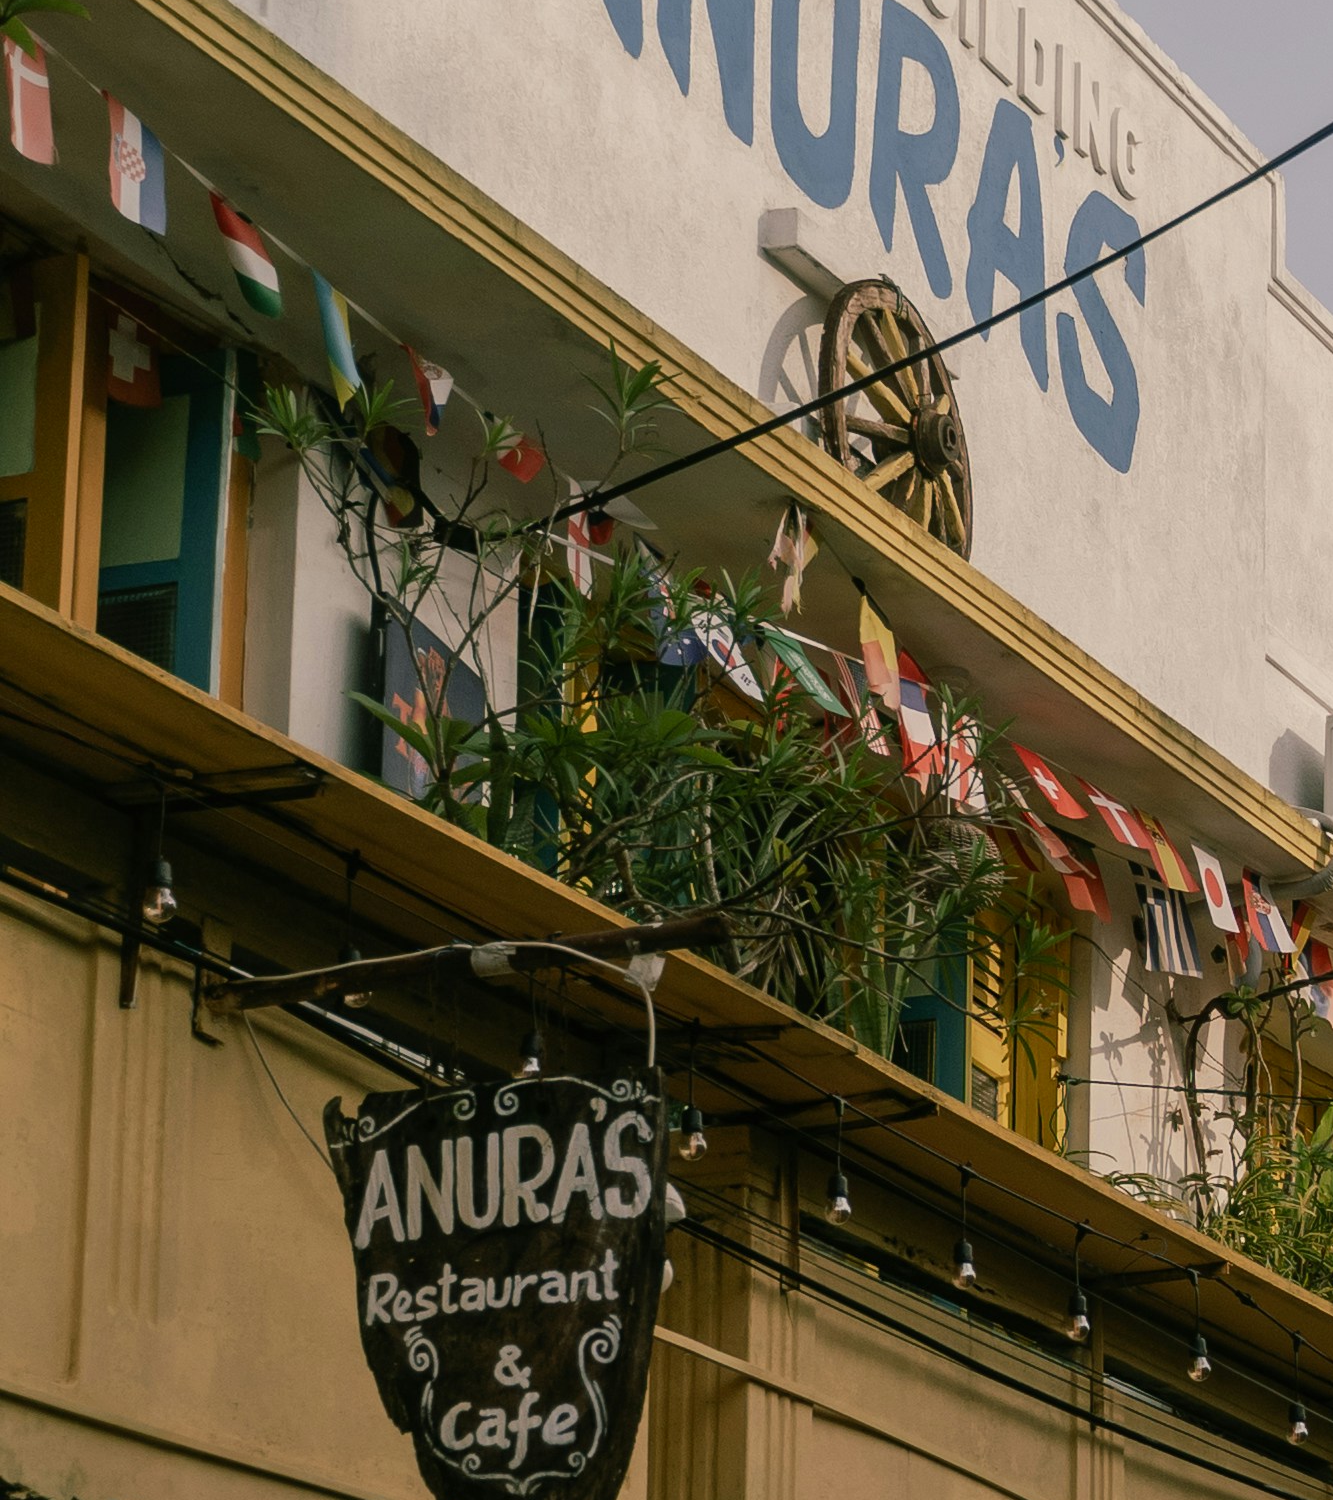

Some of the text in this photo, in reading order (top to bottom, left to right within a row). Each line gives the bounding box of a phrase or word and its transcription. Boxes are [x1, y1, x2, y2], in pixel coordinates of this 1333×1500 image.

[354, 1097, 654, 1250] ANURA'S
[365, 1249, 620, 1326] Restaurant
[493, 1344, 532, 1389] &
